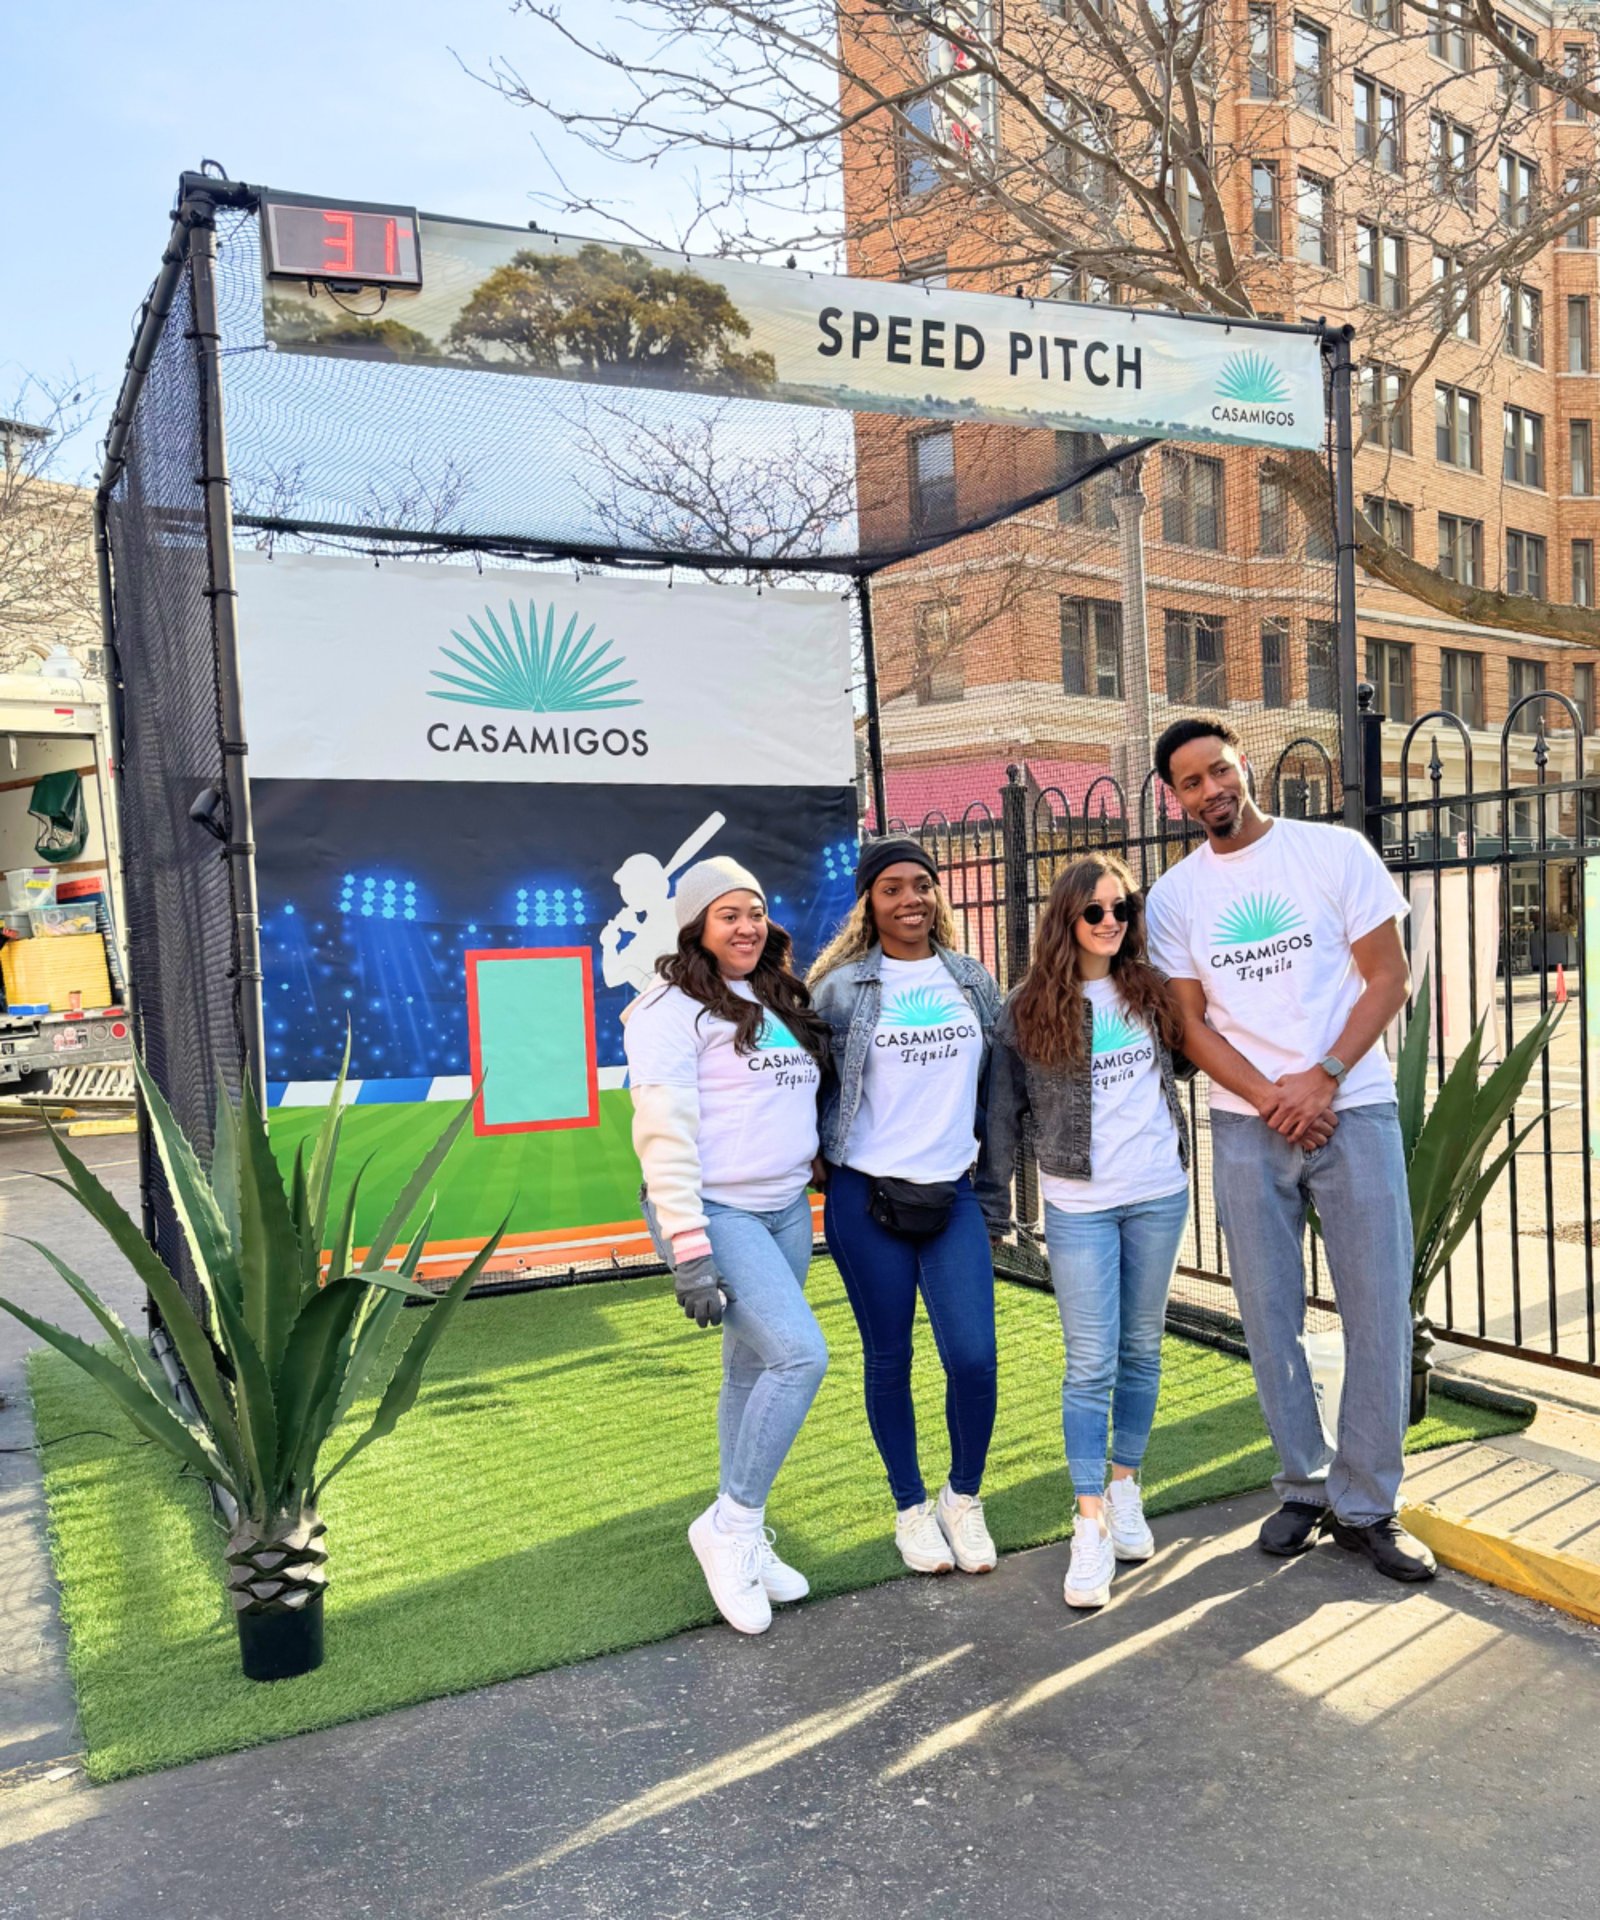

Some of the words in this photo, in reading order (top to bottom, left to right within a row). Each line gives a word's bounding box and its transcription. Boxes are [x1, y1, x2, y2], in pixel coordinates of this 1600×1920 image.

[817, 306, 986, 371] SPEED
[1009, 331, 1143, 390] PITCH
[1211, 405, 1295, 427] CASAMIGOS
[426, 722, 649, 757] CASAMIGOS
[1210, 933, 1313, 969] CASAMIGOS
[1236, 957, 1292, 982] Tequila
[874, 1024, 977, 1048] CASAMIGOS
[747, 1053, 818, 1072] CASAMIG
[900, 1044, 958, 1066] Tequila
[1092, 1047, 1153, 1072] AMIGOS
[775, 1069, 817, 1090] Tequila
[1093, 1066, 1135, 1090] equila
